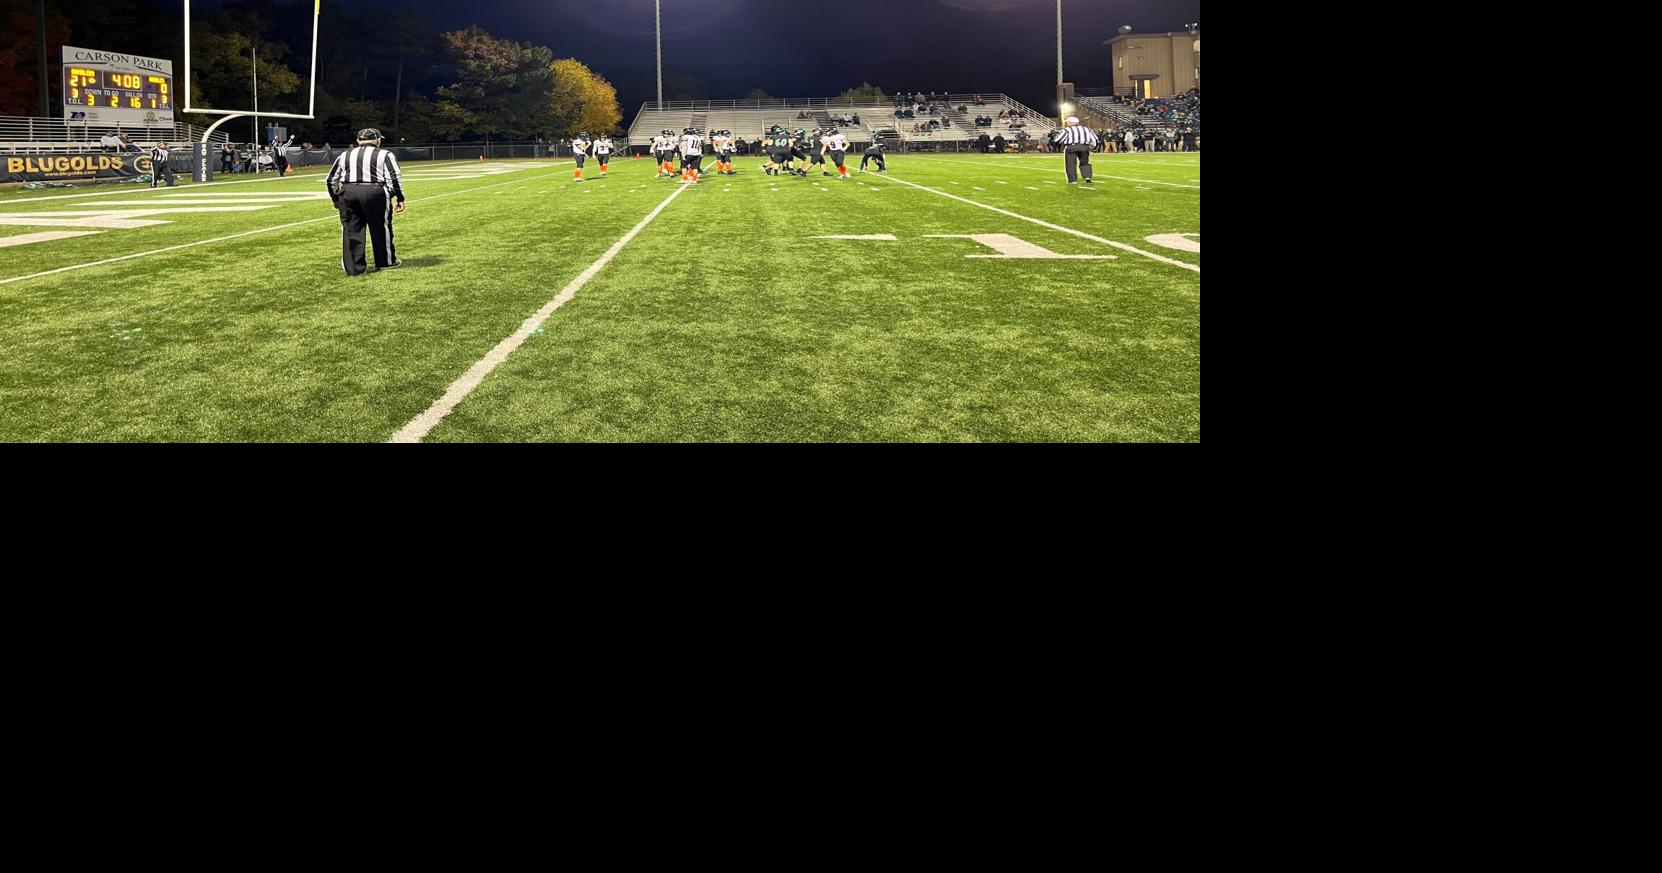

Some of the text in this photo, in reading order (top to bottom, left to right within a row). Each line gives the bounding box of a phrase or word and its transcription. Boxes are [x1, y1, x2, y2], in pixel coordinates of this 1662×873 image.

[75, 51, 163, 70] CARSON PARK
[72, 88, 79, 99] 3
[85, 88, 102, 96] DOWN
[161, 83, 167, 94] 0
[88, 95, 95, 106] 3
[111, 96, 118, 107] 2
[130, 97, 141, 108] 16
[151, 99, 157, 109] 1
[162, 95, 167, 104] 3
[774, 138, 788, 147] 60
[7, 156, 124, 173] BLUGOLDS
